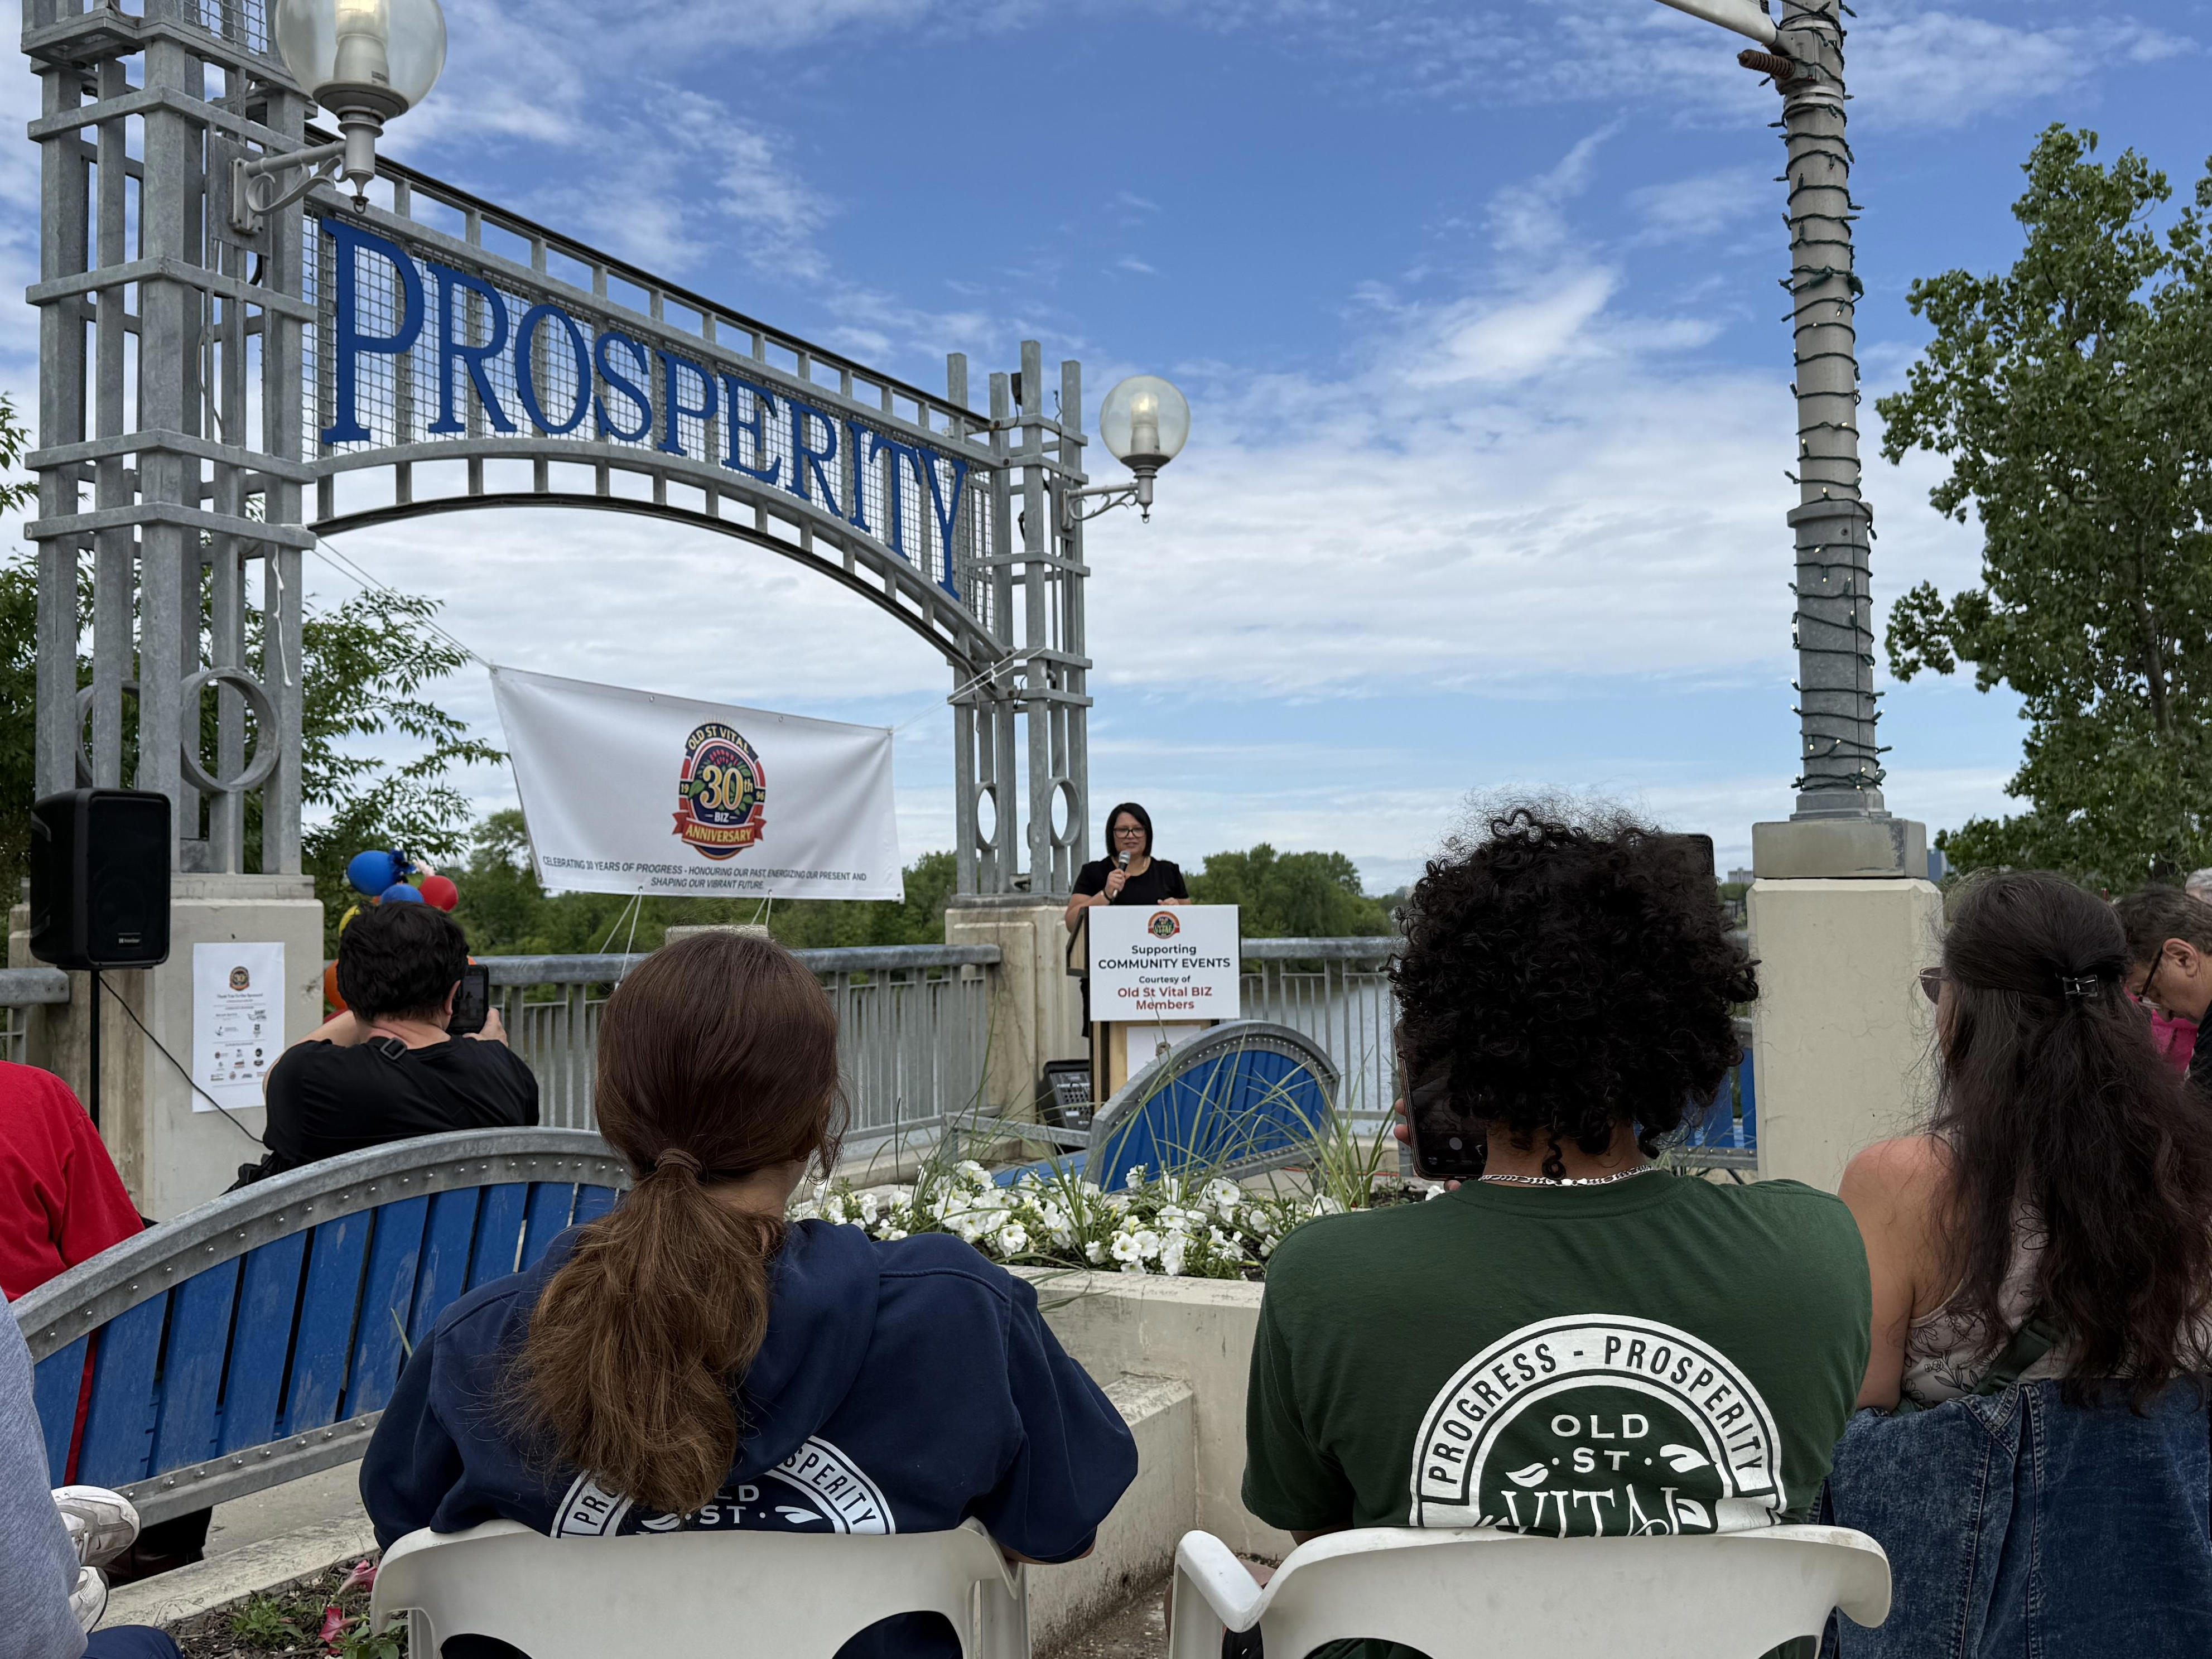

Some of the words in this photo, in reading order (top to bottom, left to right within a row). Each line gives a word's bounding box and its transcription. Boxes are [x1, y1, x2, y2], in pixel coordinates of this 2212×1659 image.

[321, 217, 969, 600] PROSPERITY
[688, 729, 705, 750] OLD
[705, 725, 718, 737] ST
[719, 726, 749, 754] VITAL
[681, 783, 690, 793] 19
[700, 765, 753, 811] 30th
[756, 791, 764, 801] 96
[714, 812, 730, 823] BIZ
[686, 824, 753, 842] ANNIVERSARY
[543, 855, 585, 870] CELEBRATING
[586, 860, 594, 870] 30
[594, 861, 620, 872] YEARS
[621, 862, 634, 872] OF
[636, 862, 683, 875] PROGRESS
[688, 866, 732, 877] HONOURING
[734, 867, 749, 877] OUR
[749, 868, 766, 878] PAST,
[767, 869, 806, 880] ENERGIZING
[806, 871, 818, 880] OUR
[819, 871, 850, 881] PRESENT
[852, 872, 867, 881] AND
[650, 876, 687, 888] SHAPING
[688, 878, 705, 888] OUR
[706, 879, 736, 889] VIBRANT
[1131, 944, 1197, 956] Supporting
[1098, 958, 1178, 970] COMMUNITY
[1182, 958, 1231, 968] EVENTS
[1139, 976, 1179, 985] Courtesy
[1117, 987, 1139, 997] Old
[1143, 987, 1156, 997] St
[1159, 986, 1187, 997] Vital
[1192, 986, 1212, 996] BIZ
[1136, 999, 1195, 1010] Members
[1428, 1343, 1556, 1484] PROGRESS
[1604, 1335, 1763, 1471] PROSPERITY
[1551, 1414, 1649, 1438] OLD
[1573, 1446, 1630, 1473] ST
[715, 1484, 759, 1502] LD
[699, 1505, 746, 1525] ST
